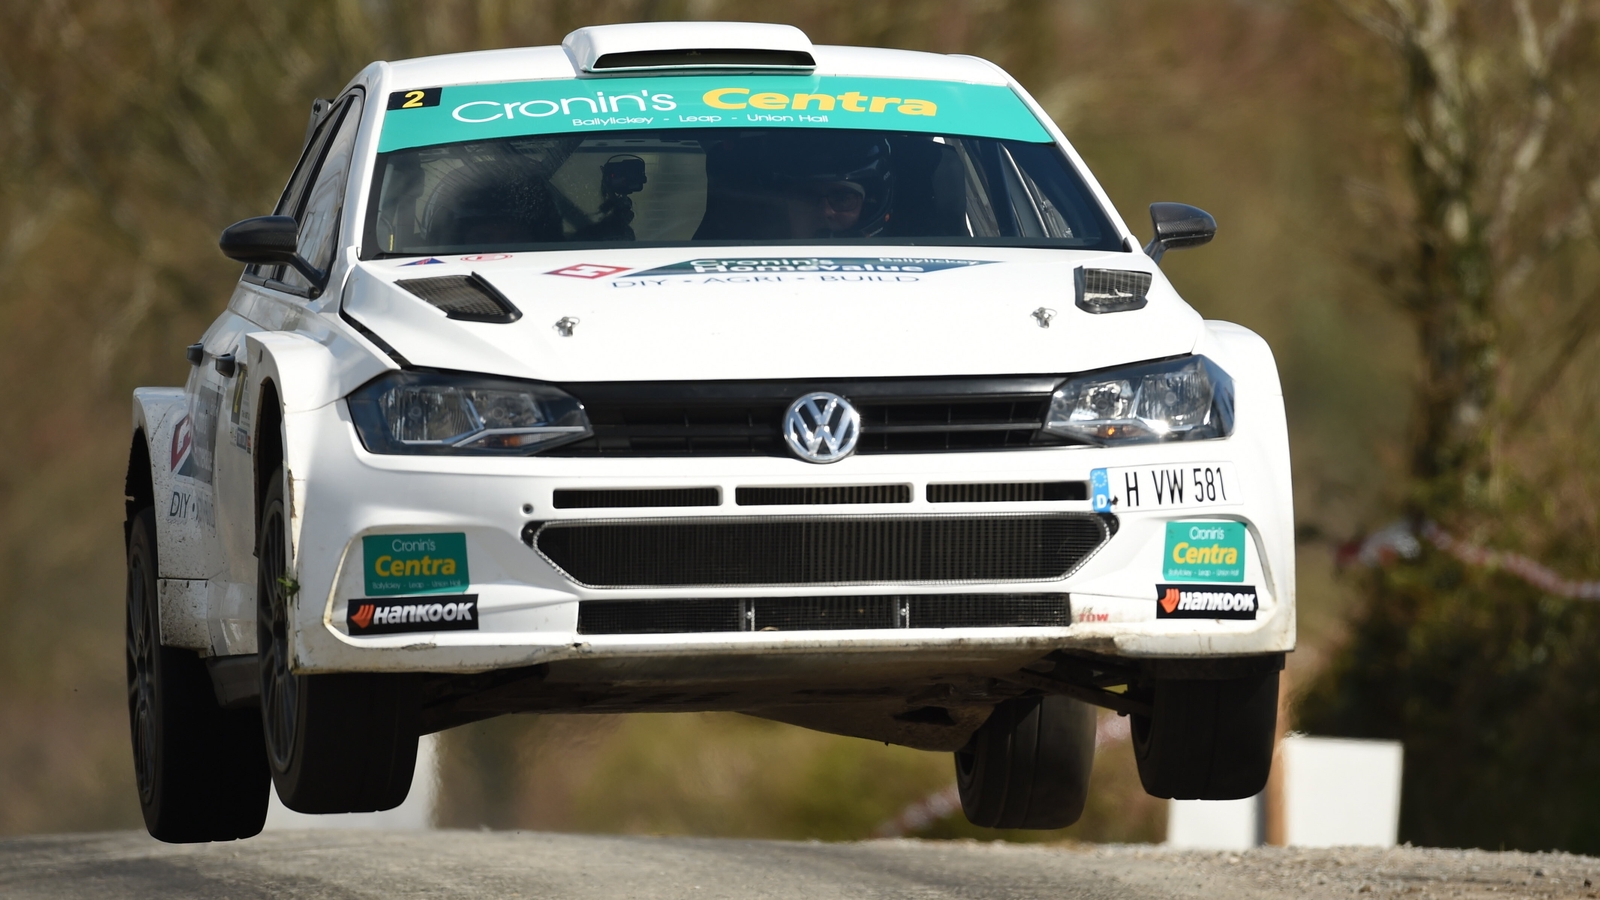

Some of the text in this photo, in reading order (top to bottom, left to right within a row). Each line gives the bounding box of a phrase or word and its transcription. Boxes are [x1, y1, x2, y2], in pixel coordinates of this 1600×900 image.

[402, 90, 425, 108] 2
[452, 87, 938, 122] Cronin's Centra
[572, 115, 654, 127] Ballylickey
[679, 114, 722, 124] Leap
[747, 114, 793, 123] Union
[799, 114, 829, 123] Hall
[693, 264, 925, 272] Homevalue
[612, 279, 667, 288] DIY
[704, 276, 782, 284] AGRI
[1096, 467, 1227, 508] D H VW 581
[169, 491, 191, 517] DIY
[1189, 526, 1225, 540] Cronin's
[392, 539, 436, 552] Cronin's
[1172, 542, 1238, 565] Centra
[375, 555, 456, 577] Centra
